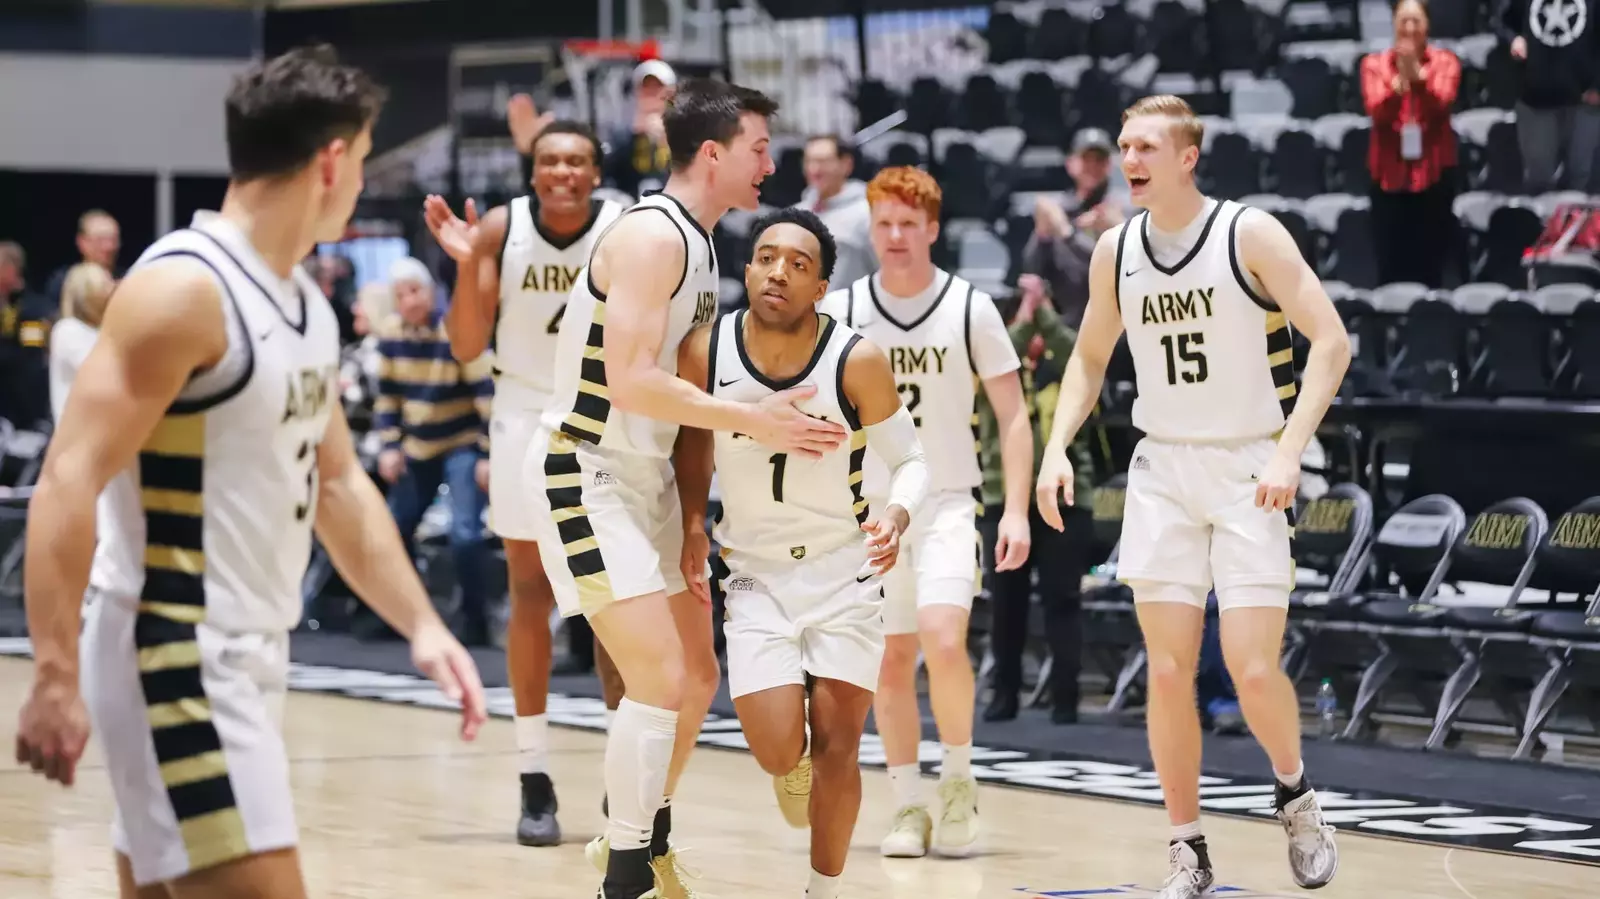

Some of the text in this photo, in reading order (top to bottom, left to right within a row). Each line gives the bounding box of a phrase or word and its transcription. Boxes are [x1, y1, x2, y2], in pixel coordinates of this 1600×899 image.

[521, 264, 581, 292] ARM
[691, 291, 717, 324] ARM
[1141, 287, 1214, 325] ARMY
[889, 346, 948, 374] RMY
[1160, 332, 1208, 386] 15
[769, 453, 787, 503] 1
[1548, 512, 1600, 550] ARM
